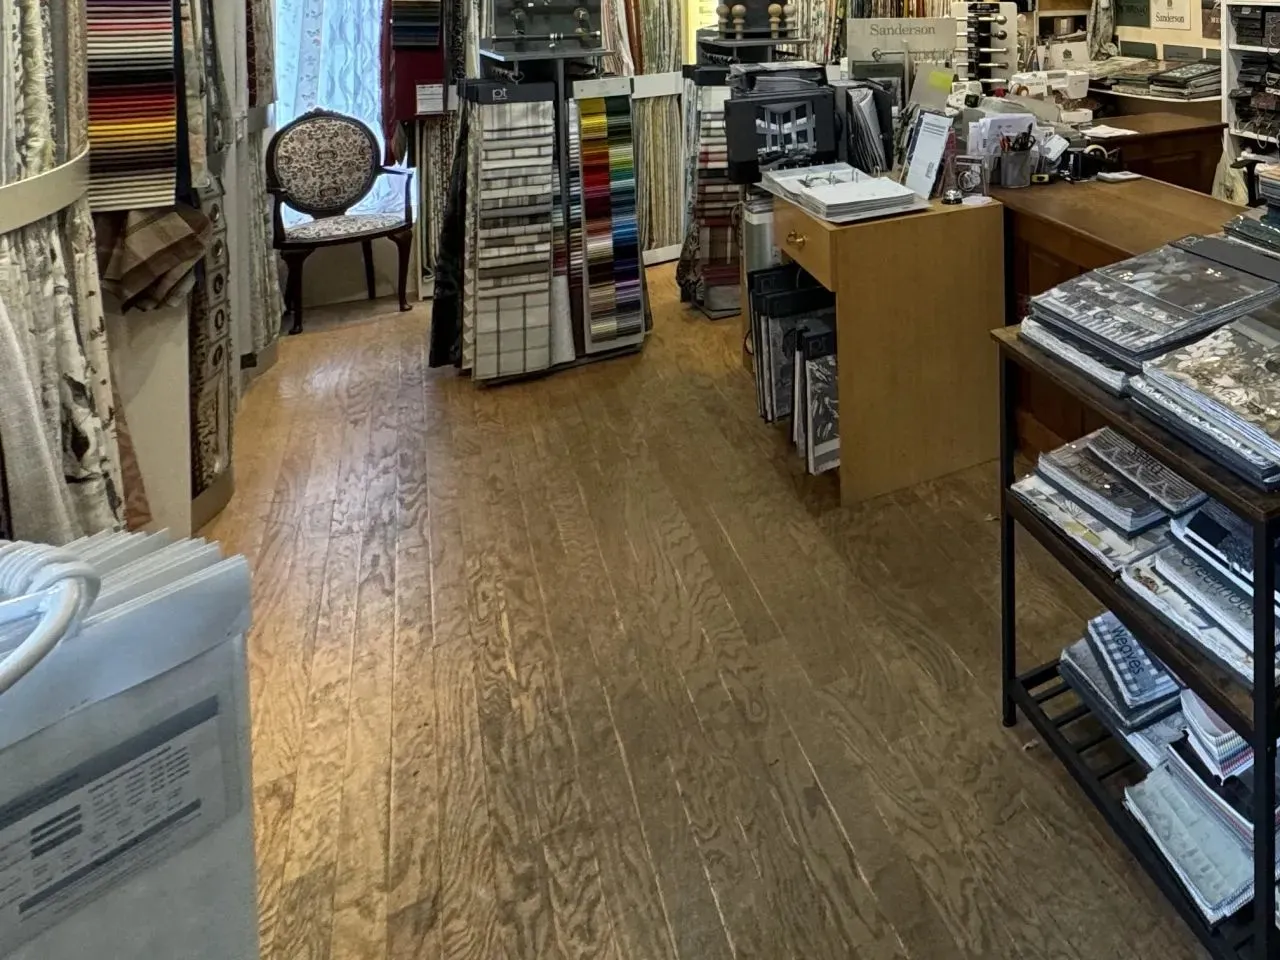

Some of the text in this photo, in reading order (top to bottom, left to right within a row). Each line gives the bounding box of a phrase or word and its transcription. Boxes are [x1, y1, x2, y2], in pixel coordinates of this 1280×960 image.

[1155, 12, 1185, 23] Sanderson
[870, 23, 936, 36] Sanderson
[1112, 625, 1145, 675] Weaves
